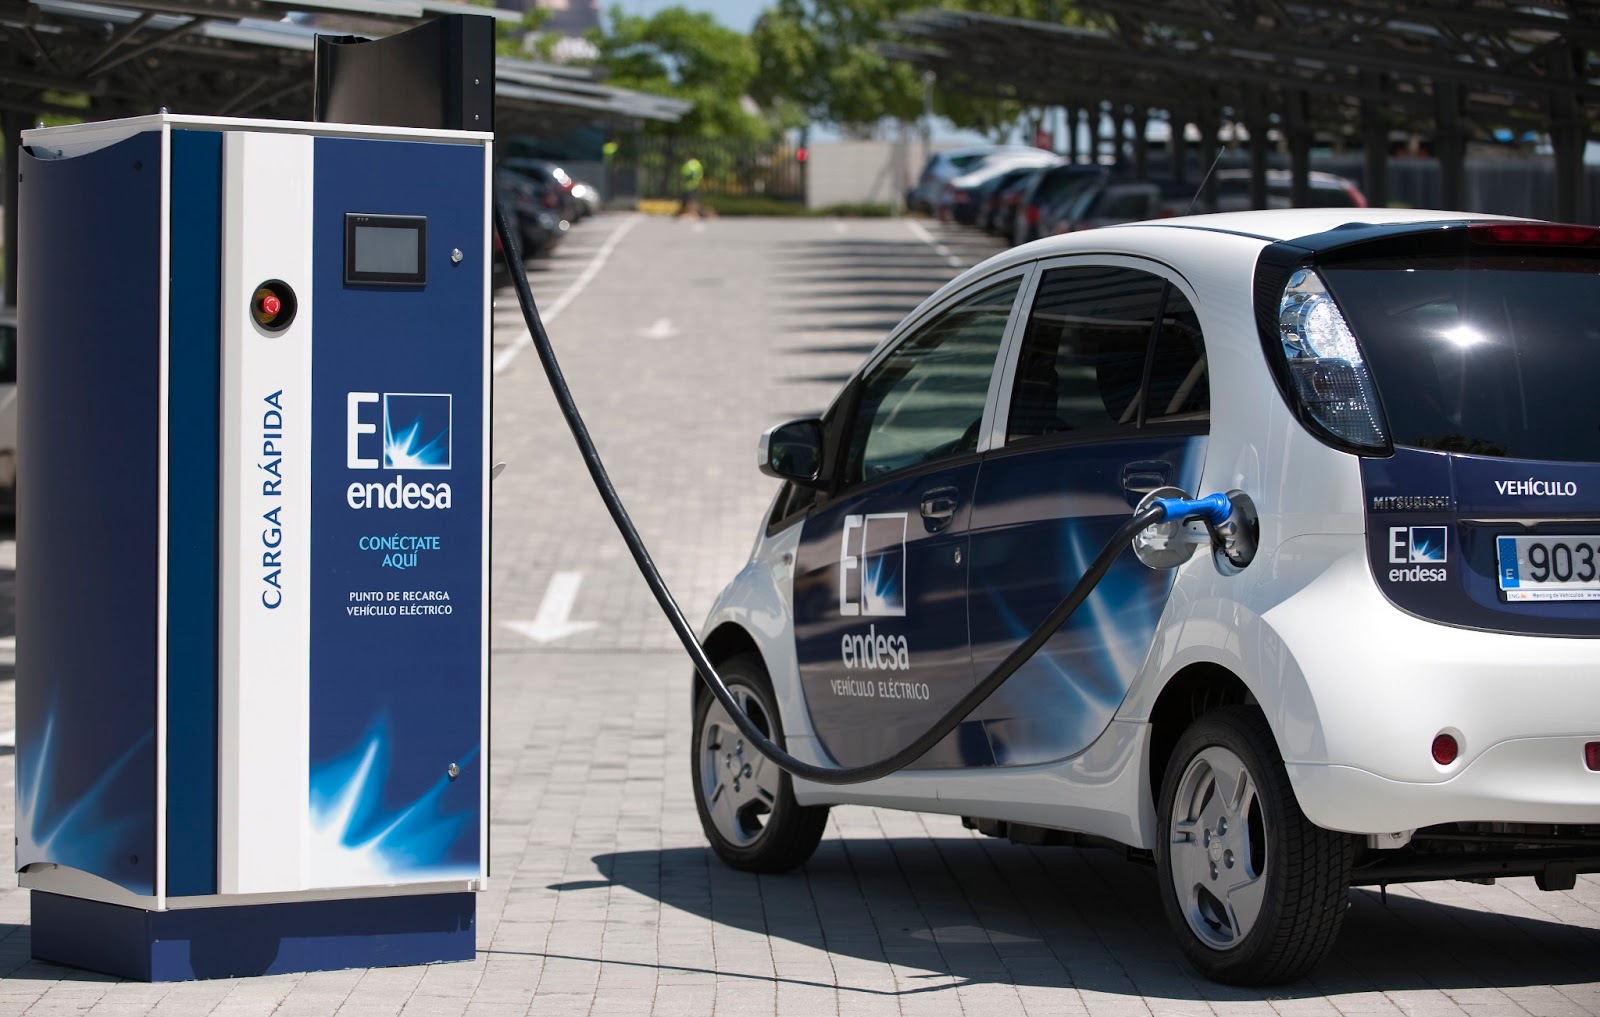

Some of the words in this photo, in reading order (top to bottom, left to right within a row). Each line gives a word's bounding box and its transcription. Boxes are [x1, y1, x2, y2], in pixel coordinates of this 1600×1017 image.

[257, 389, 283, 496] RÁPIDA
[347, 475, 452, 509] endesa
[1495, 478, 1577, 496] VEHÍCULO
[1373, 496, 1449, 510] MITSUBISHI
[359, 533, 441, 551] CONÉCTATE
[262, 506, 282, 610] CARGA
[382, 551, 418, 570] AQUÍ
[1528, 542, 1600, 583] 903
[1389, 565, 1447, 582] endesa
[1505, 568, 1514, 580] E
[349, 591, 384, 602] PUNTO
[386, 591, 400, 602] DE
[403, 591, 450, 601] RECARGA
[347, 603, 397, 616] VEHÍCULO
[400, 603, 452, 615] ELÉCTRICO
[841, 624, 910, 671] endesa
[831, 676, 874, 697] VEHÍCULO
[879, 678, 930, 700] ELÉCTRICO
